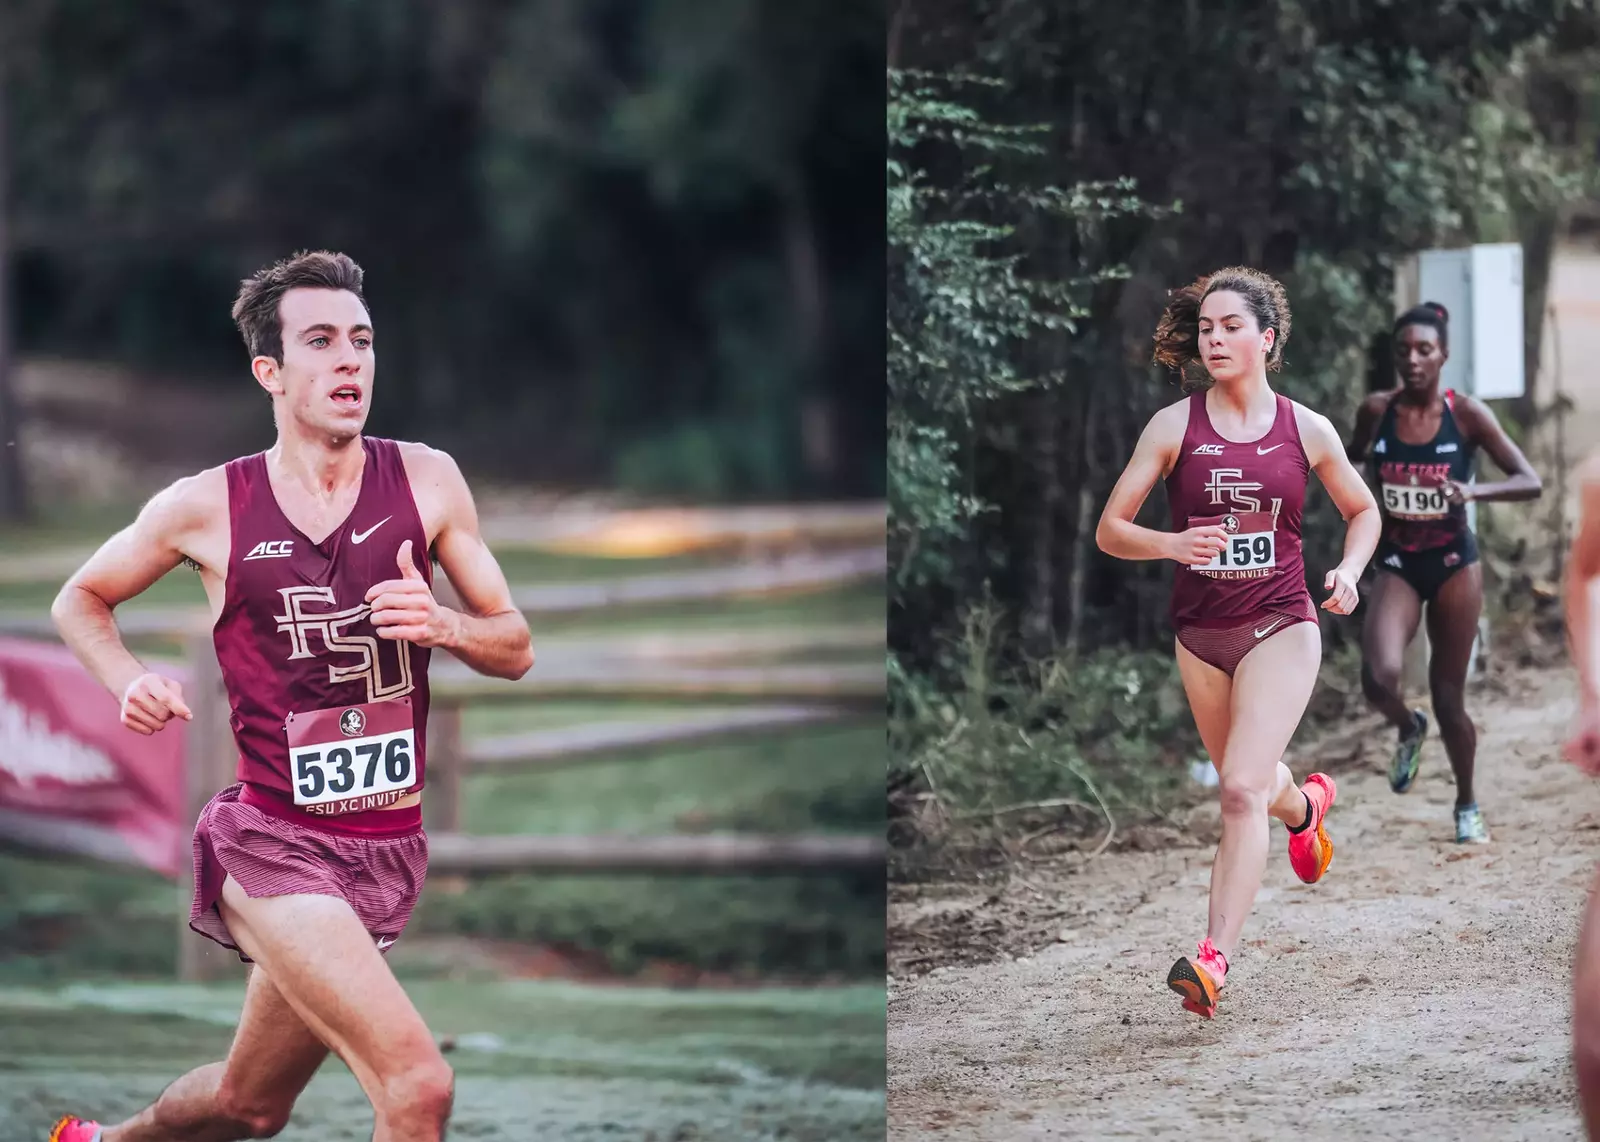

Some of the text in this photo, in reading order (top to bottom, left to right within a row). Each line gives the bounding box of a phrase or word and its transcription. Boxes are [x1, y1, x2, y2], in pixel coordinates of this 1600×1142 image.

[1193, 443, 1226, 454] ACC
[1386, 489, 1444, 510] 5190
[245, 540, 295, 559] ACC
[1218, 536, 1271, 566] 159
[1221, 571, 1234, 579] XC
[1236, 568, 1270, 579] INVITE
[273, 586, 415, 703] FSU
[297, 738, 411, 799] 5376
[306, 789, 408, 815] FSU XC INVITE
